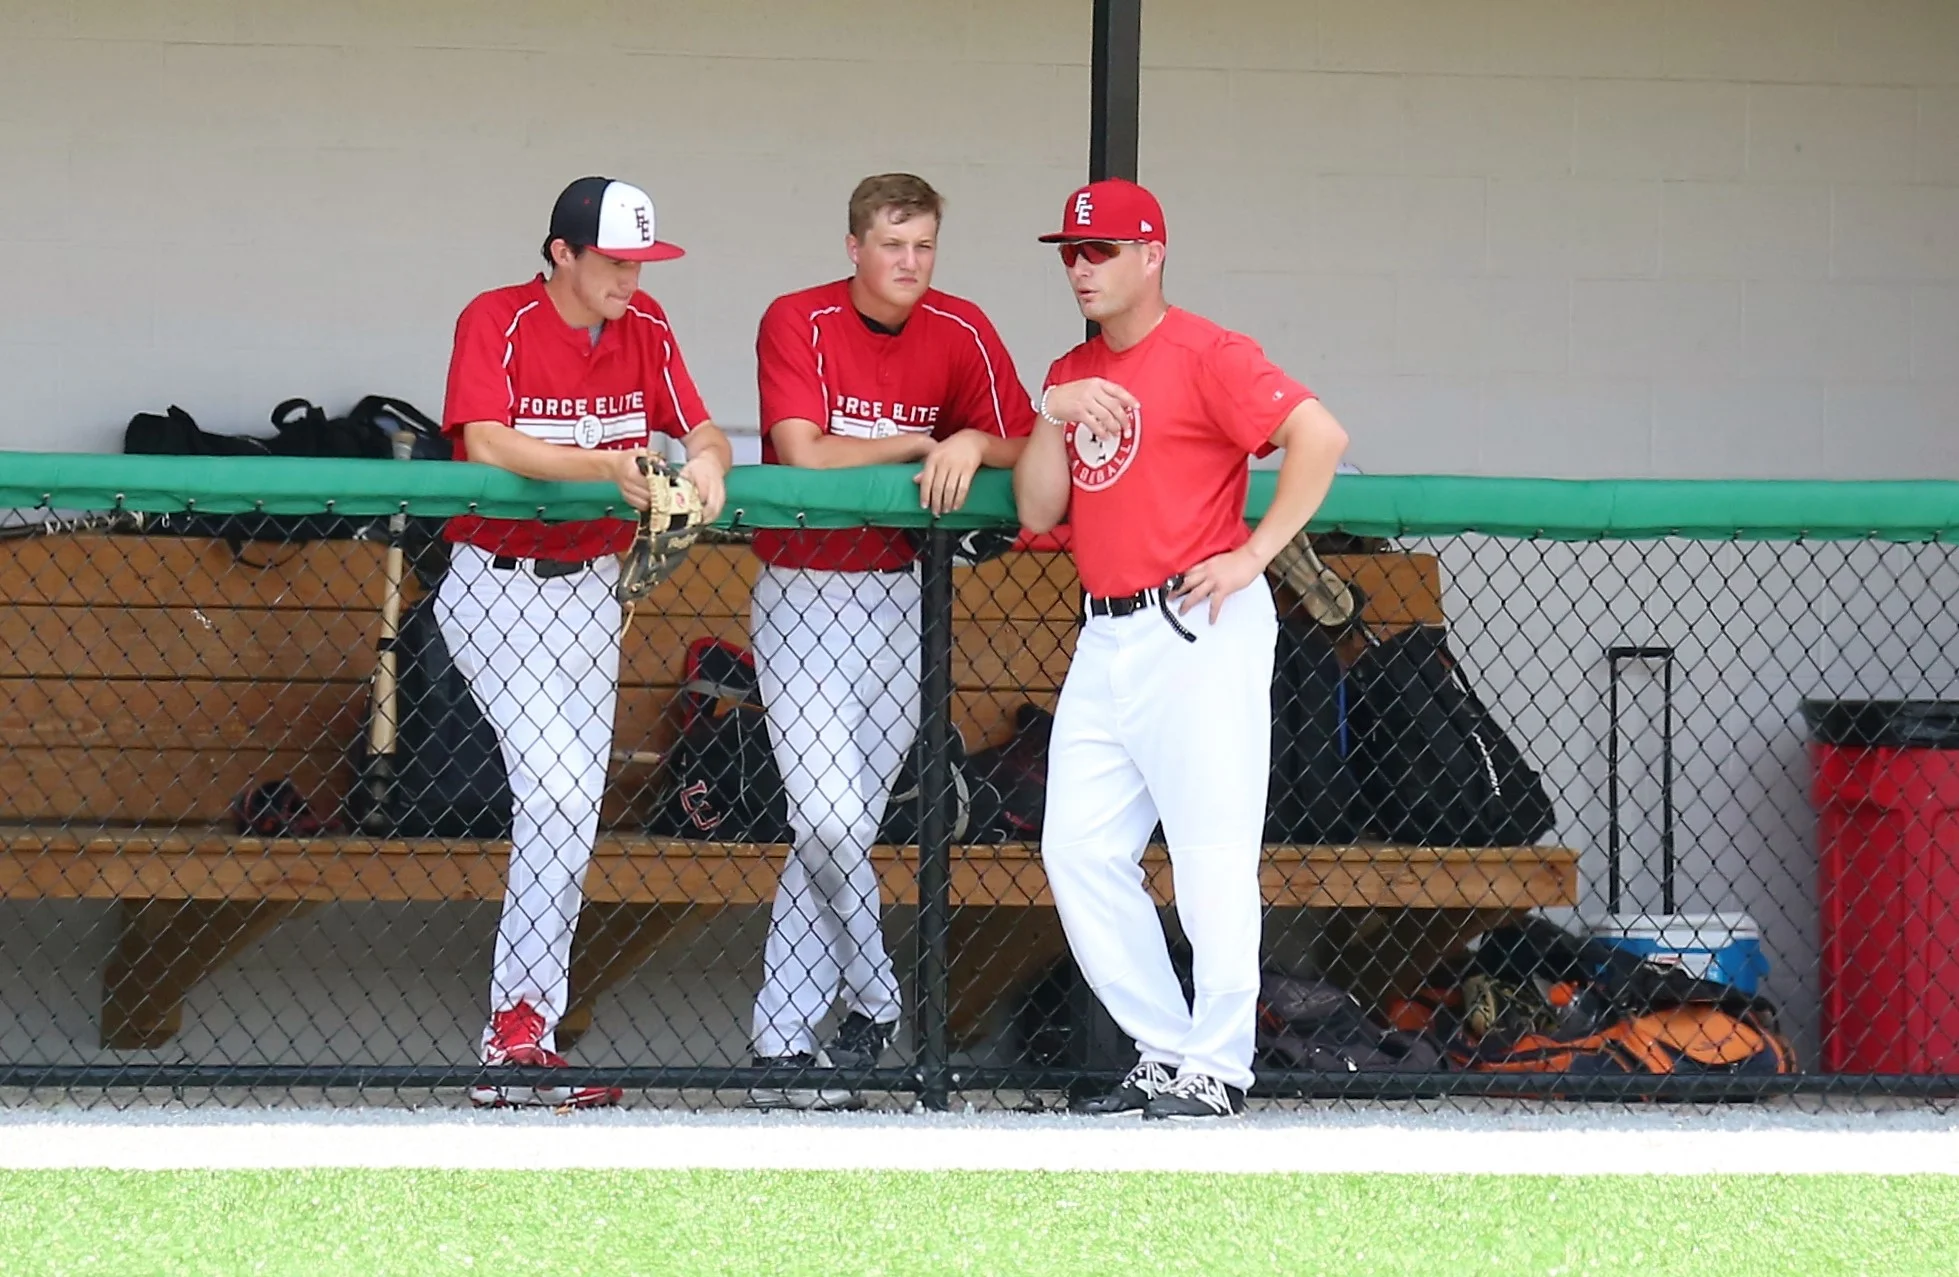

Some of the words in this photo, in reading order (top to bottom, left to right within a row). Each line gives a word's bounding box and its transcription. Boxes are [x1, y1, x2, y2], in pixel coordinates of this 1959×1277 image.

[519, 397, 588, 416] FORCE
[595, 391, 644, 415] ELITE
[836, 395, 883, 418] RCE
